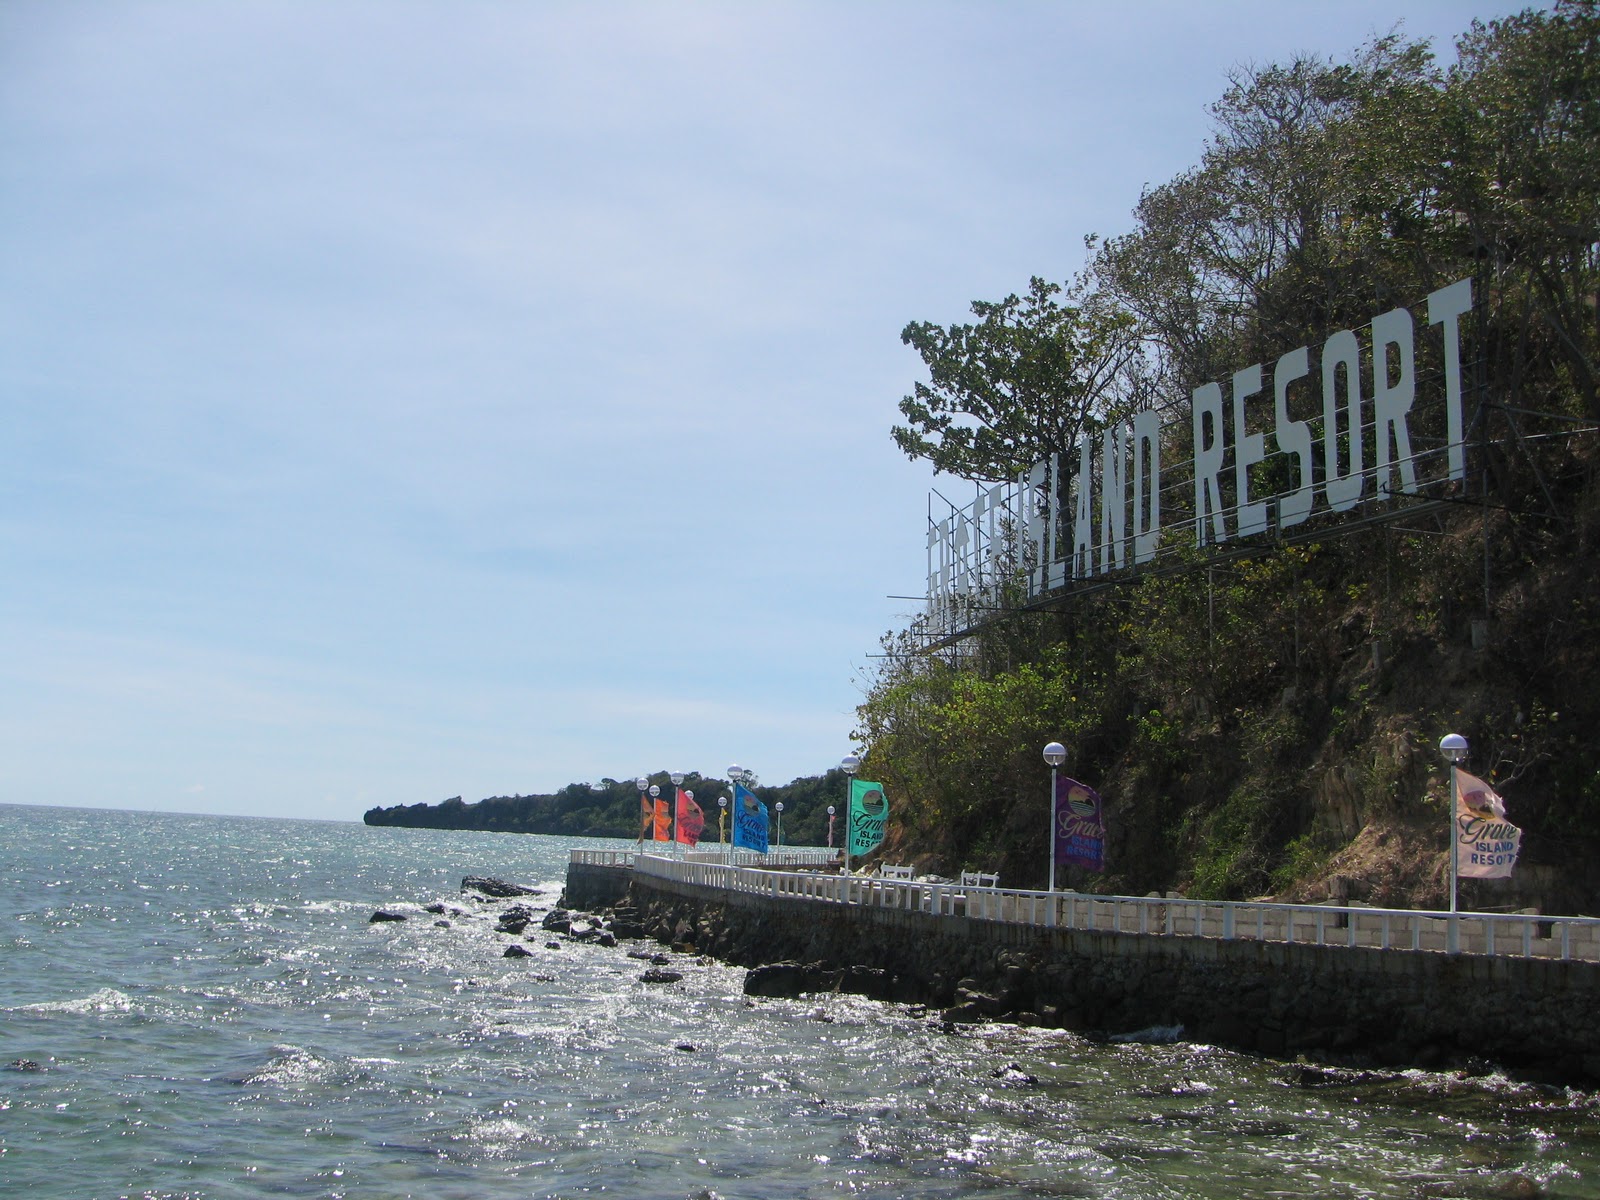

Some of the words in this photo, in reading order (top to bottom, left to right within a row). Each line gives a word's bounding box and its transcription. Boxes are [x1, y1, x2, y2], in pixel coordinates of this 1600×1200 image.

[1017, 410, 1160, 597] ISLAND
[1192, 278, 1472, 549] RESORT
[852, 810, 886, 832] Grac
[1459, 814, 1517, 844] Grace
[1071, 836, 1102, 849] ISLAND
[1475, 841, 1514, 853] ISLAND
